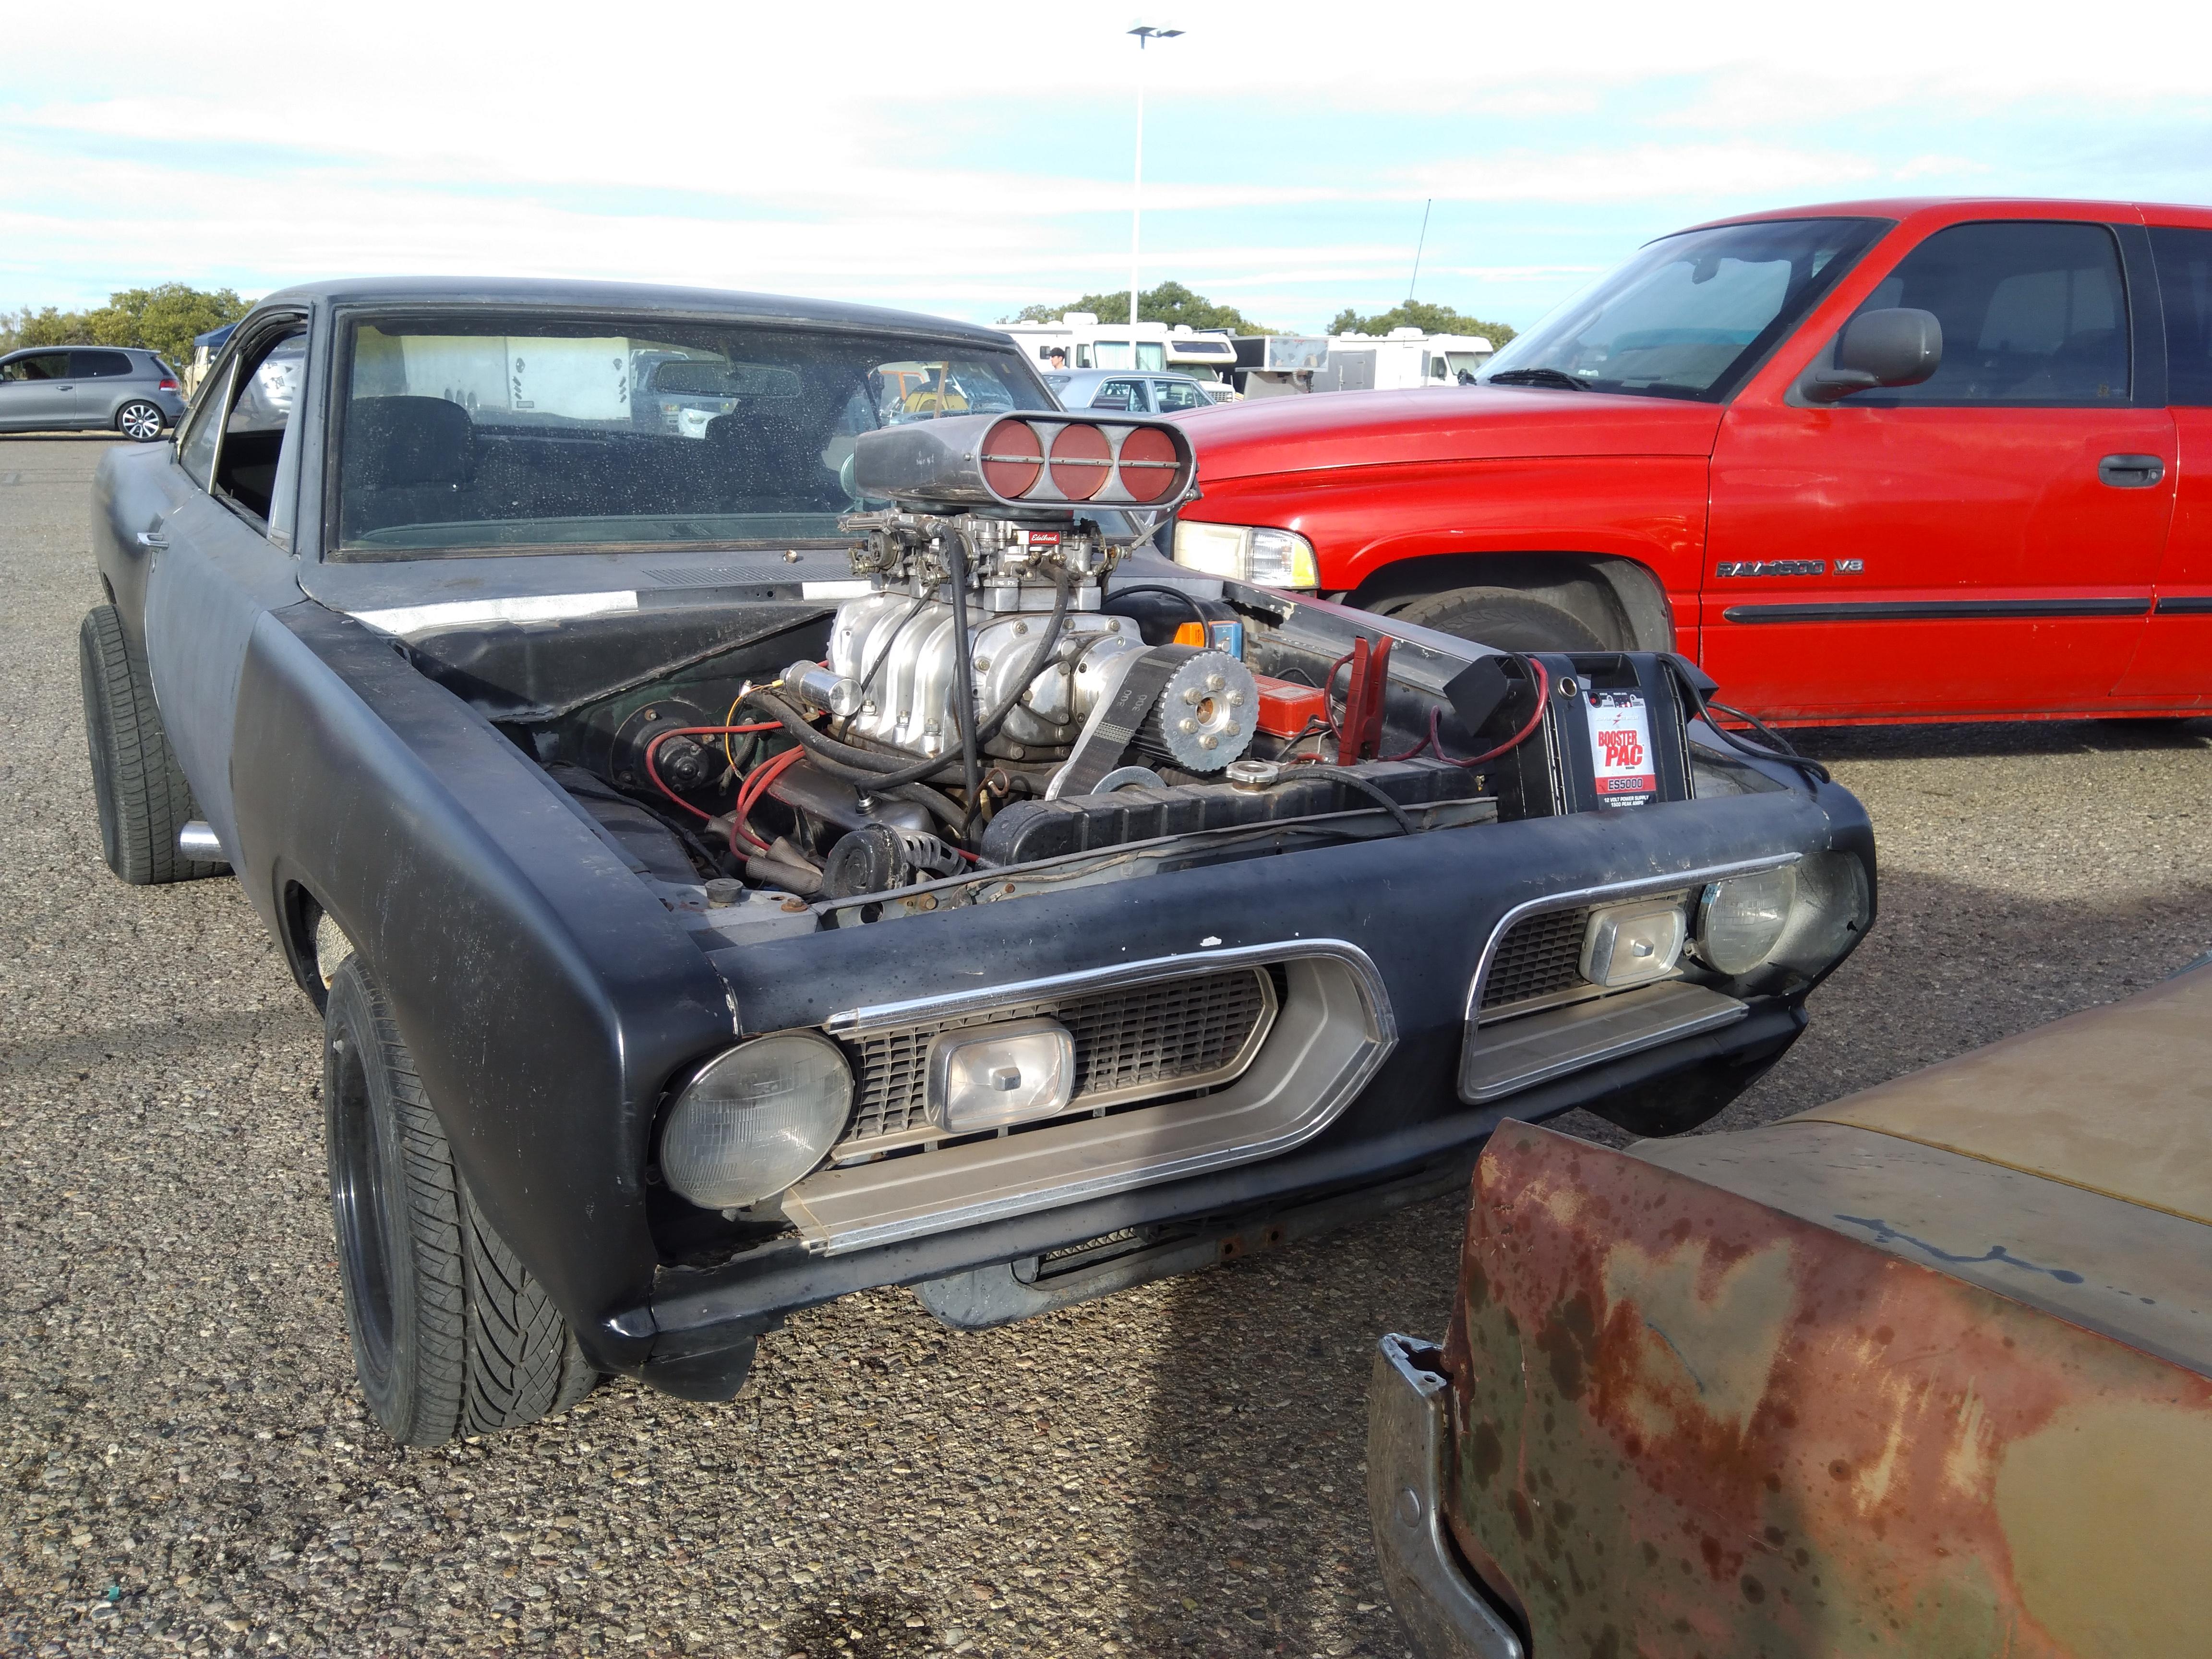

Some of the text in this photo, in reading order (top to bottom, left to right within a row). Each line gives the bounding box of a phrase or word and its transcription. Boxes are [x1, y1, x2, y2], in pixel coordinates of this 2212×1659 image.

[1031, 533, 1058, 541] Edelbrock
[1717, 562, 1763, 577] RAM
[1834, 560, 1863, 571] V8
[1132, 694, 1148, 711] 300
[1598, 730, 1637, 747] BOOSTER
[1605, 744, 1643, 767] PAC
[1608, 778, 1643, 790] ES5000
